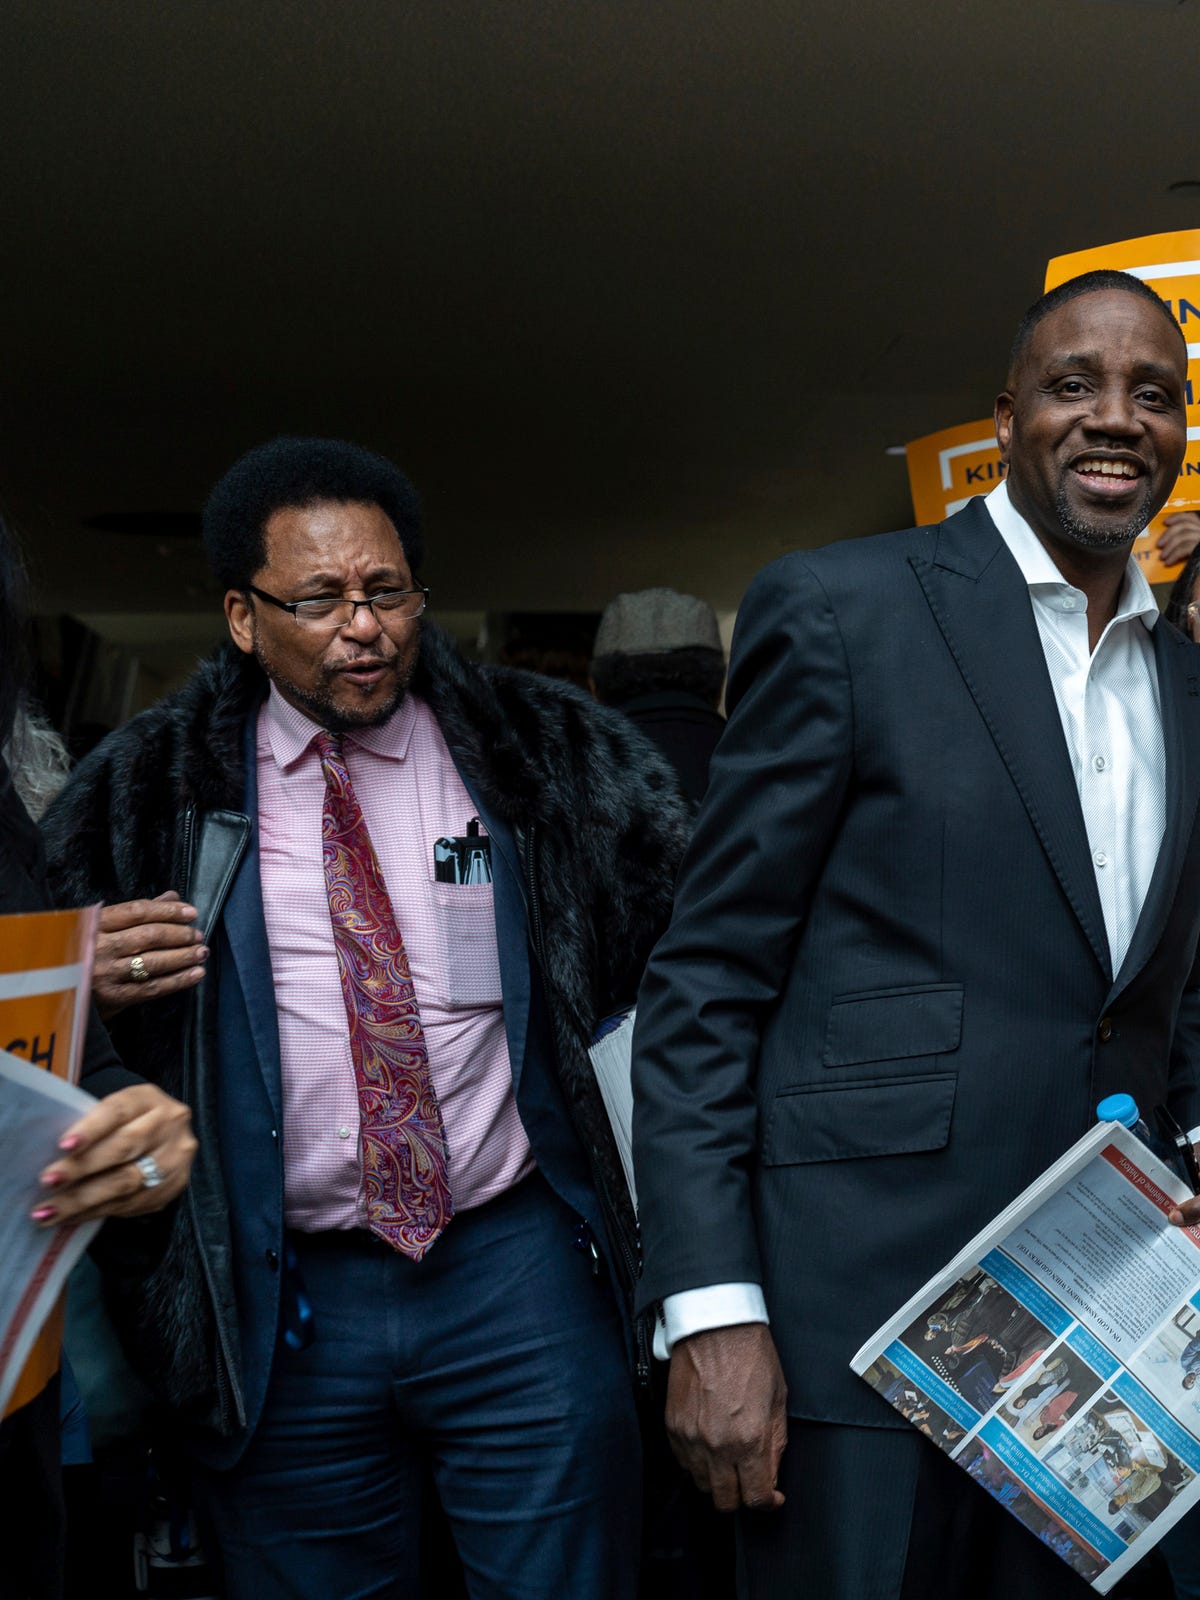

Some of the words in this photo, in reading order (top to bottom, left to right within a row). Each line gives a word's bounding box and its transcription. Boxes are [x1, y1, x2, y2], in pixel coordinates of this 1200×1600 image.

[1136, 1175, 1146, 1185] of
[1142, 1181, 1166, 1204] lifetime
[1027, 1251, 1042, 1266] PICKS
[1039, 1263, 1053, 1276] GOD
[1050, 1272, 1067, 1289] WHEN
[1095, 1317, 1110, 1331] GOD
[1111, 1332, 1122, 1342] ON
